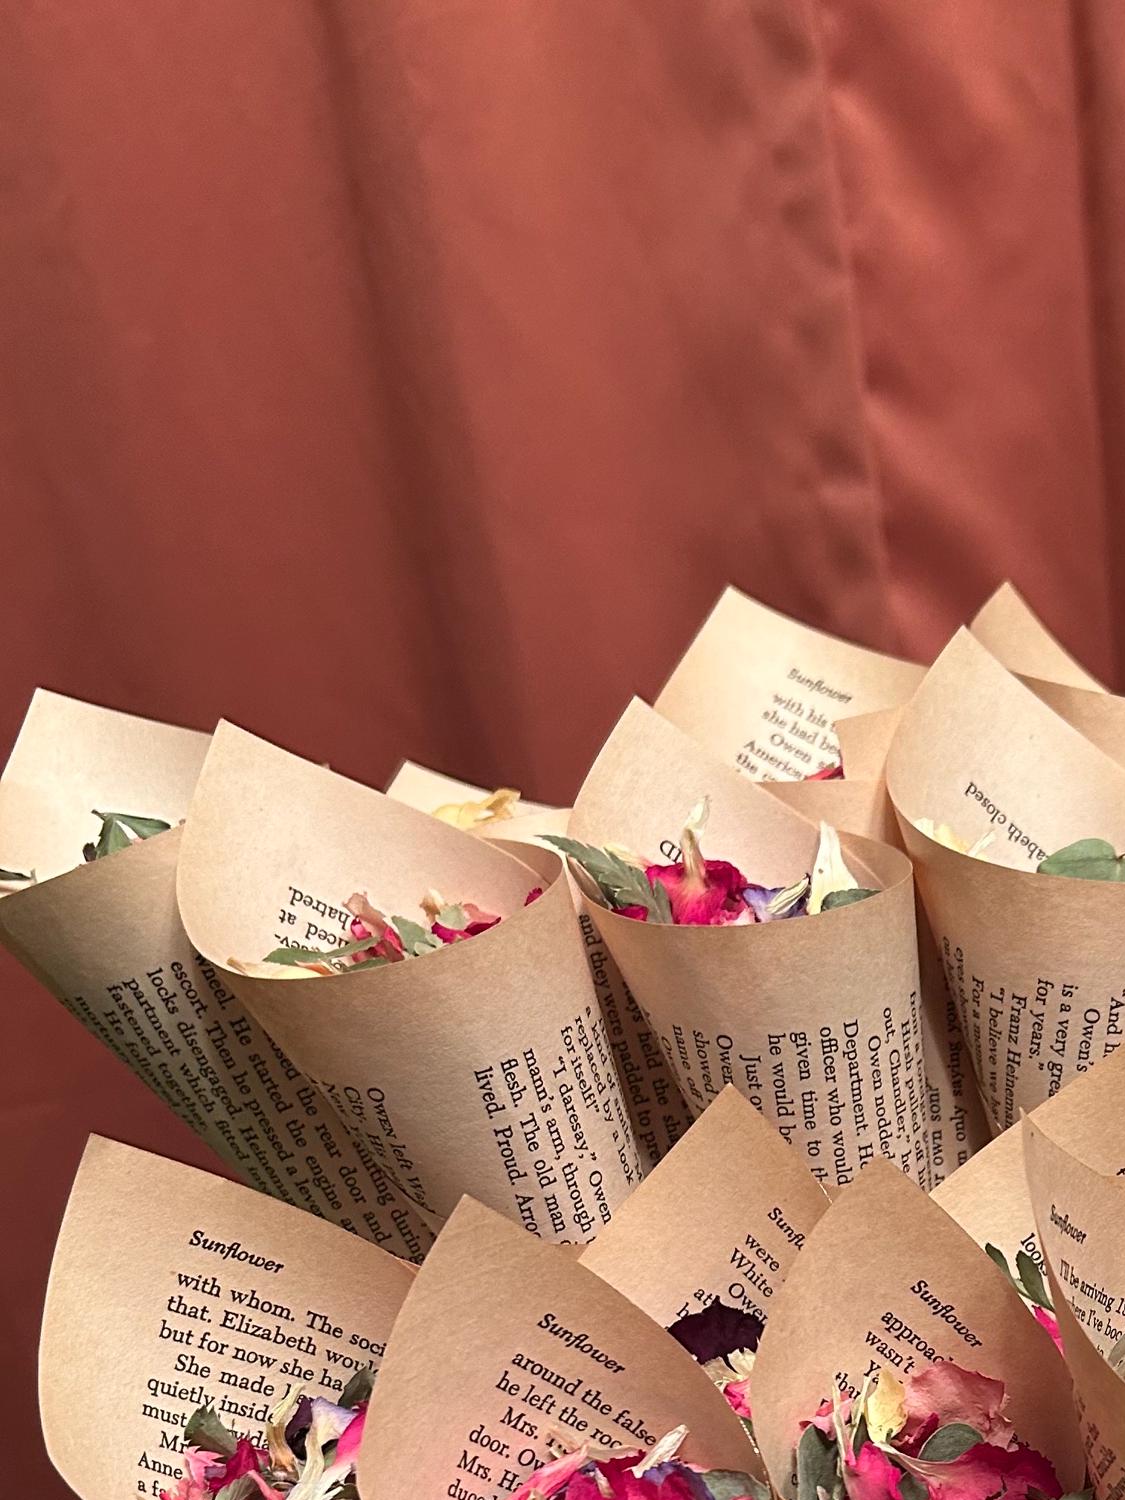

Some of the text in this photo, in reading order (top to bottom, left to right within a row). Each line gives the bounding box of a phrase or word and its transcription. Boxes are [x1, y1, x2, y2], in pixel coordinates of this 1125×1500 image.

[964, 781, 1007, 825] closed
[288, 886, 353, 932] hatred.
[1035, 977, 1055, 1006] for
[1049, 983, 1079, 1058] is a very
[145, 967, 243, 1121] locks disengaged.
[169, 961, 296, 1163] escort. Then he pressed
[611, 1039, 651, 1107] padded
[767, 1032, 796, 1118] he would
[789, 1031, 822, 1157] given time to
[819, 1026, 854, 1186] officer who would
[842, 1018, 869, 1137] Department.
[227, 1015, 343, 1211] He started the engine
[473, 1065, 528, 1186] lived. Proud.
[500, 1058, 566, 1234] flesh. The old man
[545, 1117, 566, 1161] arm,
[561, 1162, 596, 1234] through
[588, 1170, 612, 1226] Owen
[1049, 1203, 1088, 1245] Sunflower
[188, 1229, 285, 1274] Sunflower
[729, 1247, 774, 1298] White
[745, 1233, 780, 1272] were
[167, 1294, 317, 1357] that. Elizabeth
[177, 1273, 344, 1339] with whom. The
[909, 1279, 983, 1348] Sunflower
[1079, 1280, 1116, 1314] arriving
[158, 1319, 315, 1382] but for now she
[173, 1353, 275, 1397] She made
[536, 1313, 626, 1374] Sunflower
[141, 1403, 188, 1428] must
[495, 1370, 589, 1432] he left the
[499, 1405, 539, 1440] Mrs.
[511, 1353, 657, 1447] around the false
[137, 1451, 188, 1480] Anne
[468, 1423, 510, 1459] door.
